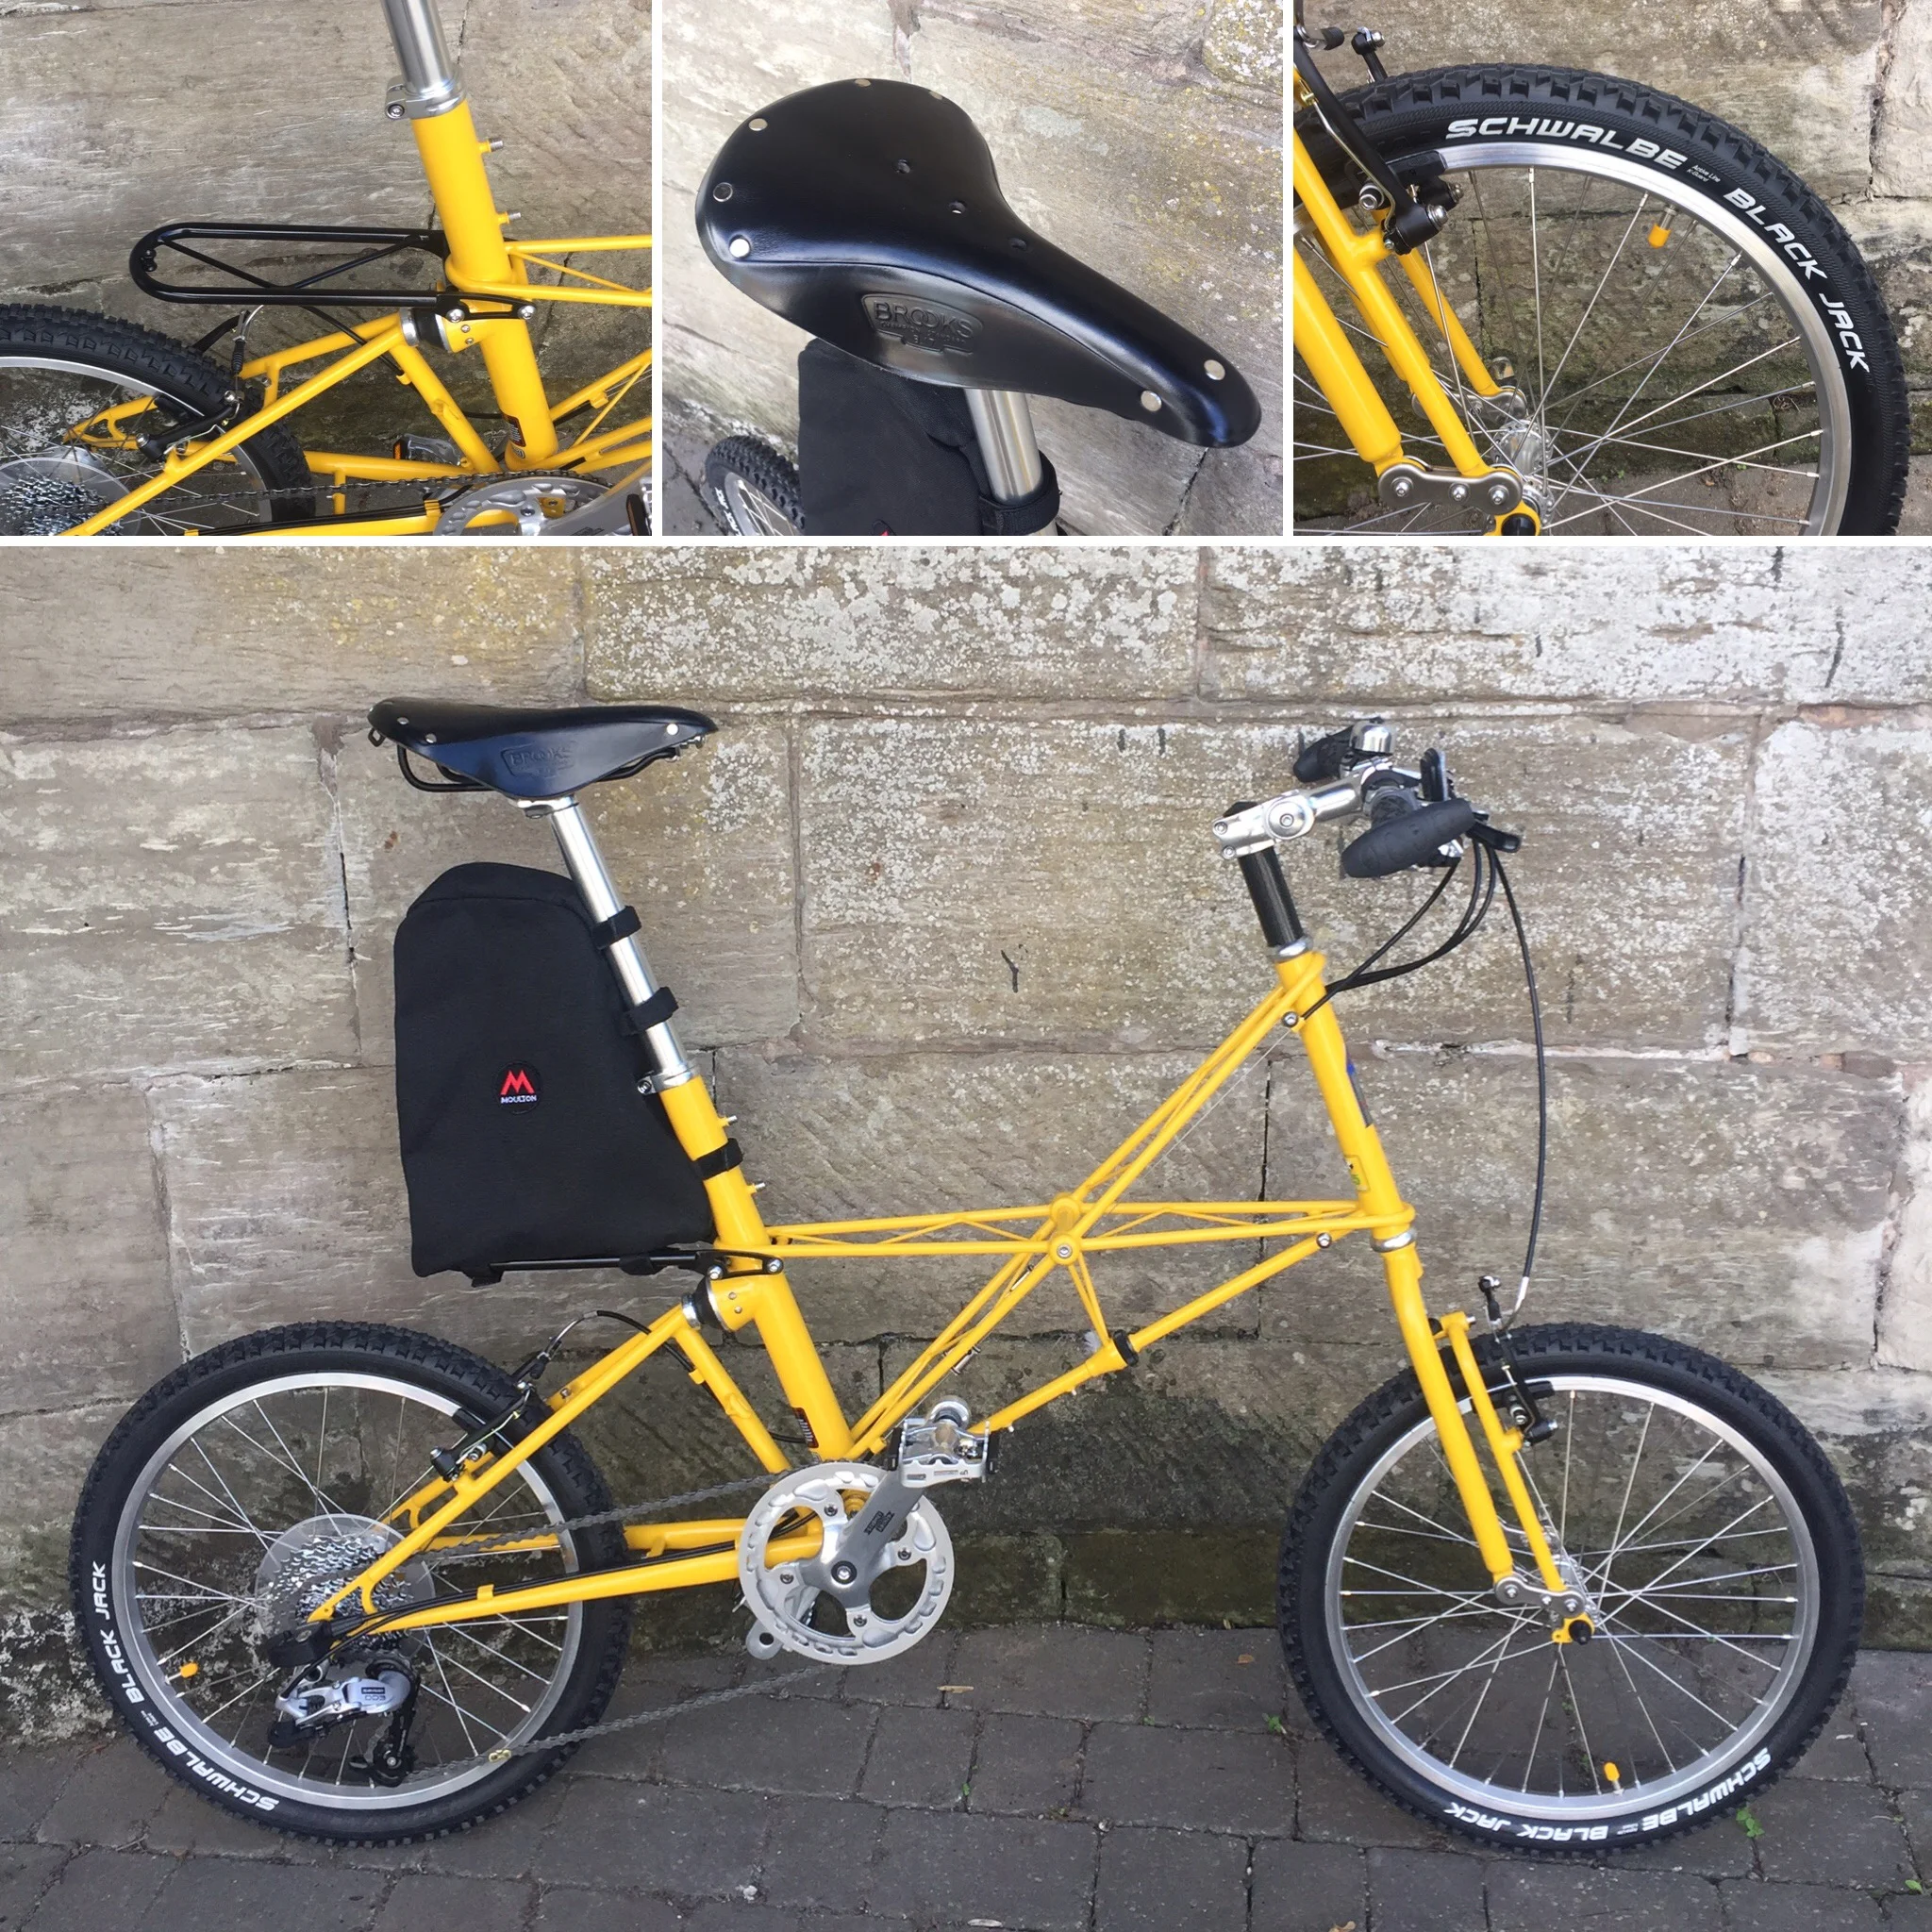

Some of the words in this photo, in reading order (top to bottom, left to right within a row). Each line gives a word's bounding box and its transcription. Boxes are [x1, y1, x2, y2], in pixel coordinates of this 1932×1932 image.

[1445, 117, 1688, 170] SCHWALBE
[1724, 187, 1828, 281] BLACK
[1819, 292, 1870, 374] JACK
[874, 300, 974, 339] BROOKS
[509, 746, 573, 767] BROOKS
[500, 1095, 537, 1104] MOULTON
[92, 1560, 110, 1621] JACK
[100, 1629, 144, 1704] BLACK
[154, 1725, 279, 1811] SCHWALBE
[1641, 1747, 1771, 1831] SCHWALBE
[1443, 1802, 1511, 1831] JACK
[1517, 1824, 1608, 1841] BLACK
